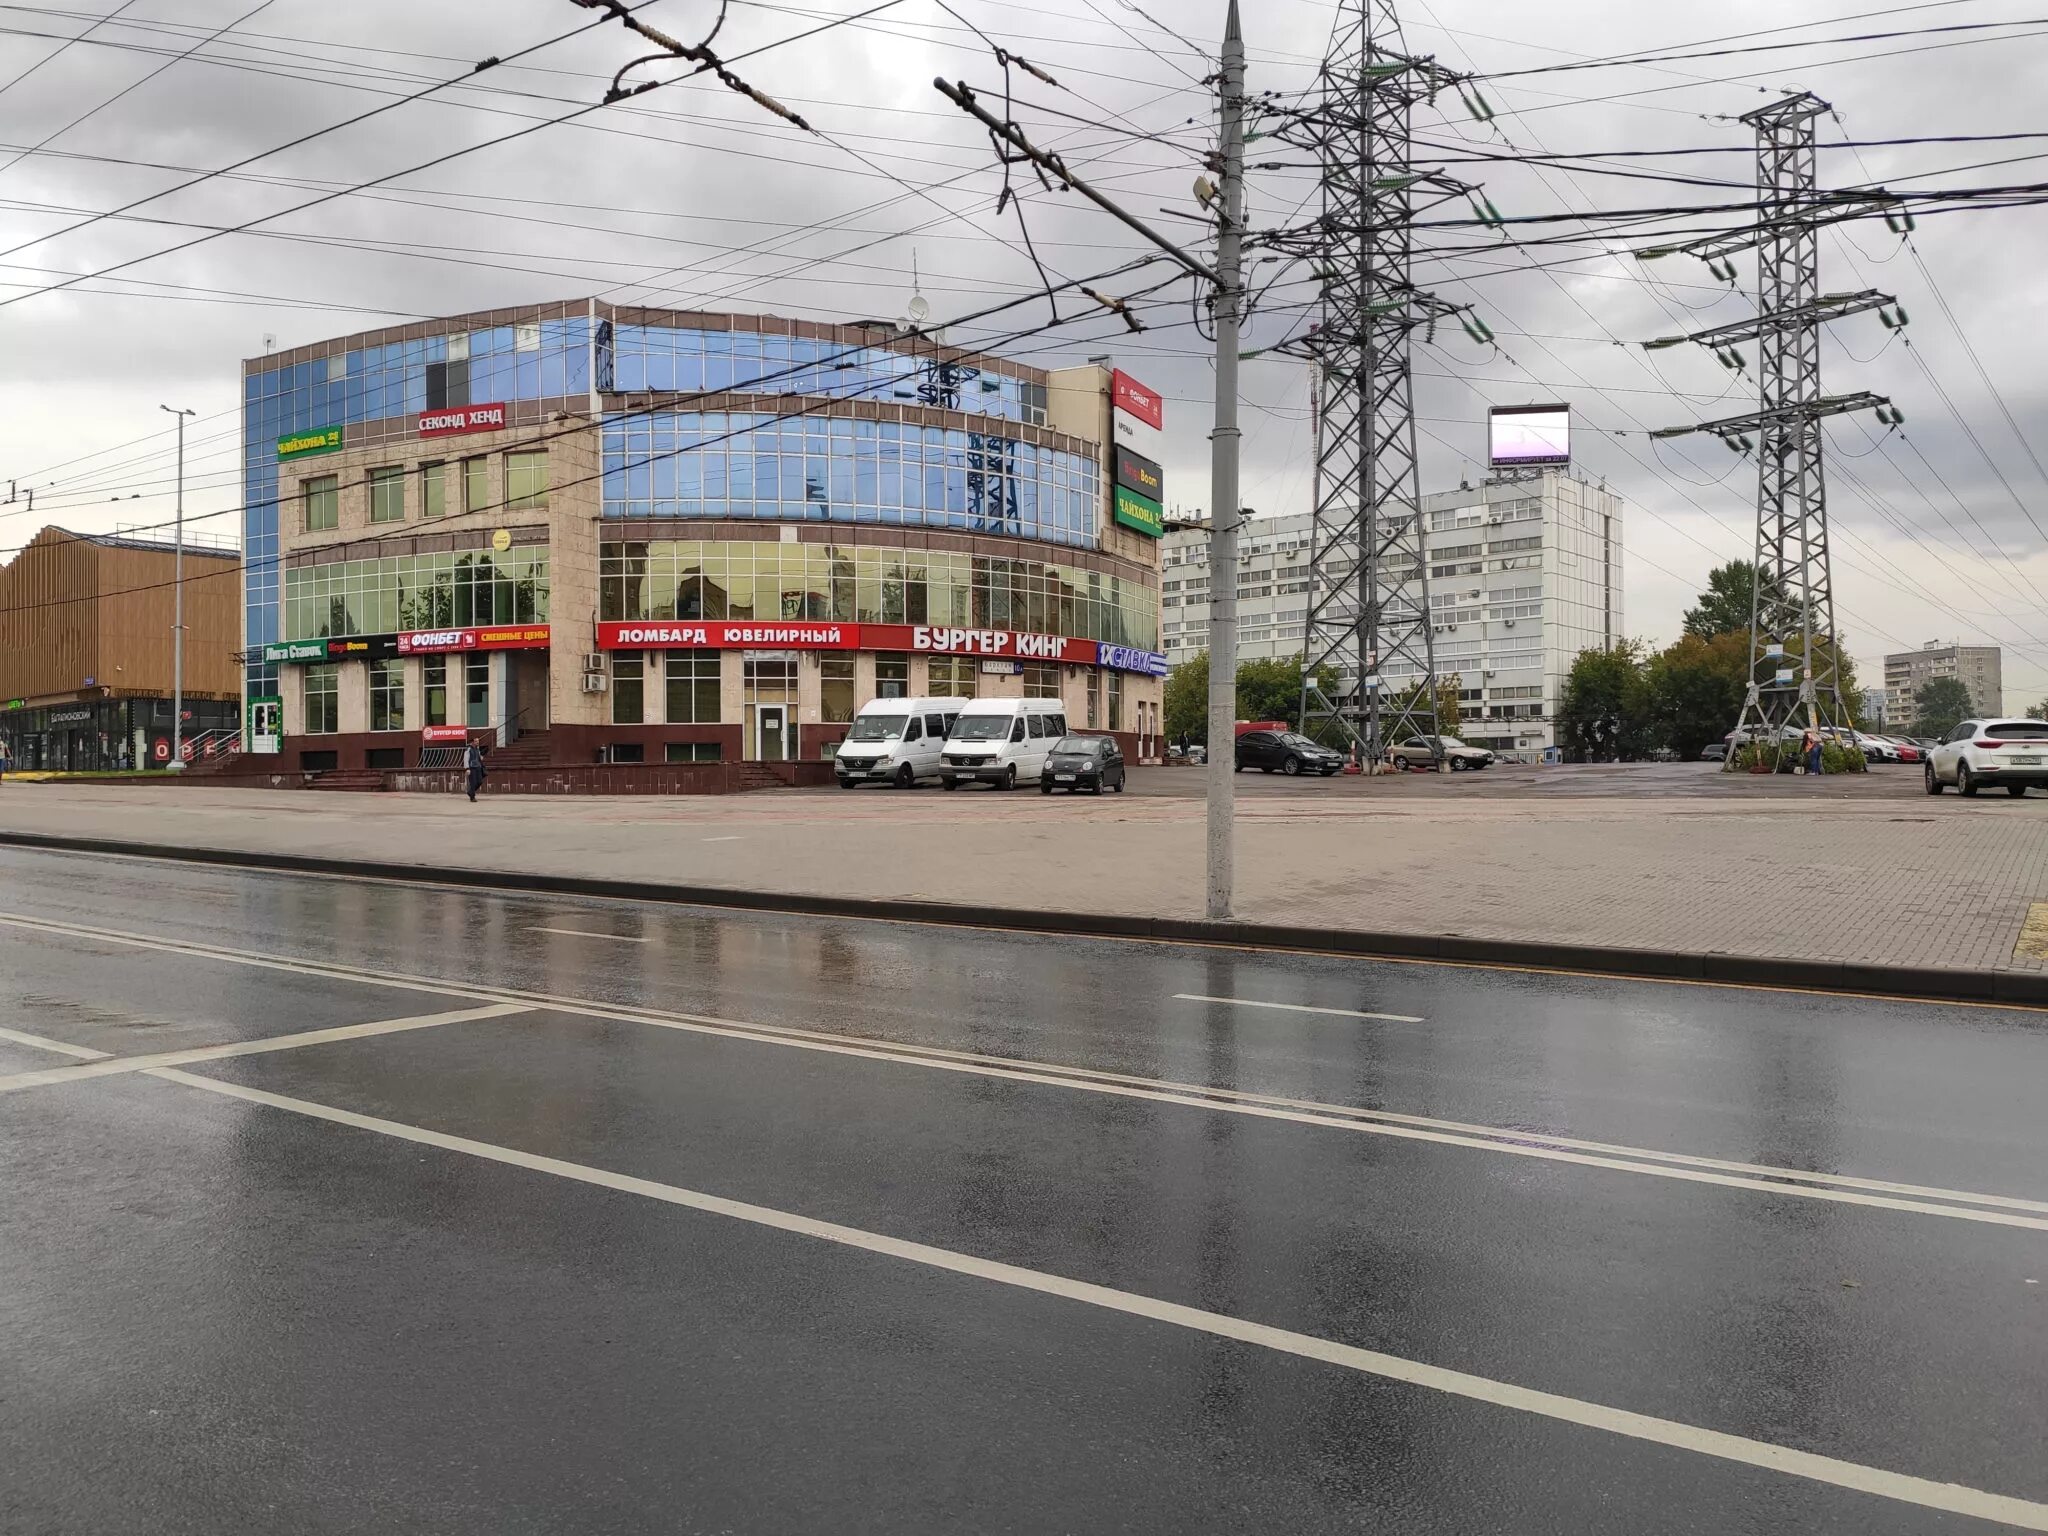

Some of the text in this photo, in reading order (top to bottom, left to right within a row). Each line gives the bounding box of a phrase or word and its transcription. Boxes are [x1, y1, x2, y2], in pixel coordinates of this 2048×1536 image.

[419, 409, 503, 431] СЕКОНД ХЕНД
[1118, 420, 1133, 437] АРЕНДА
[1119, 497, 1154, 525] ЧАЙХОНА
[411, 632, 463, 646] ФОНБЕТ
[481, 630, 548, 642] СМЕШНЫЕ ЦЕНЫ
[617, 627, 841, 644] ЛОМБАРД ЮВЕЛИРНЫЙ
[913, 626, 1067, 658] БУРГЕР КИНГ
[265, 644, 323, 661] Лига Ставок
